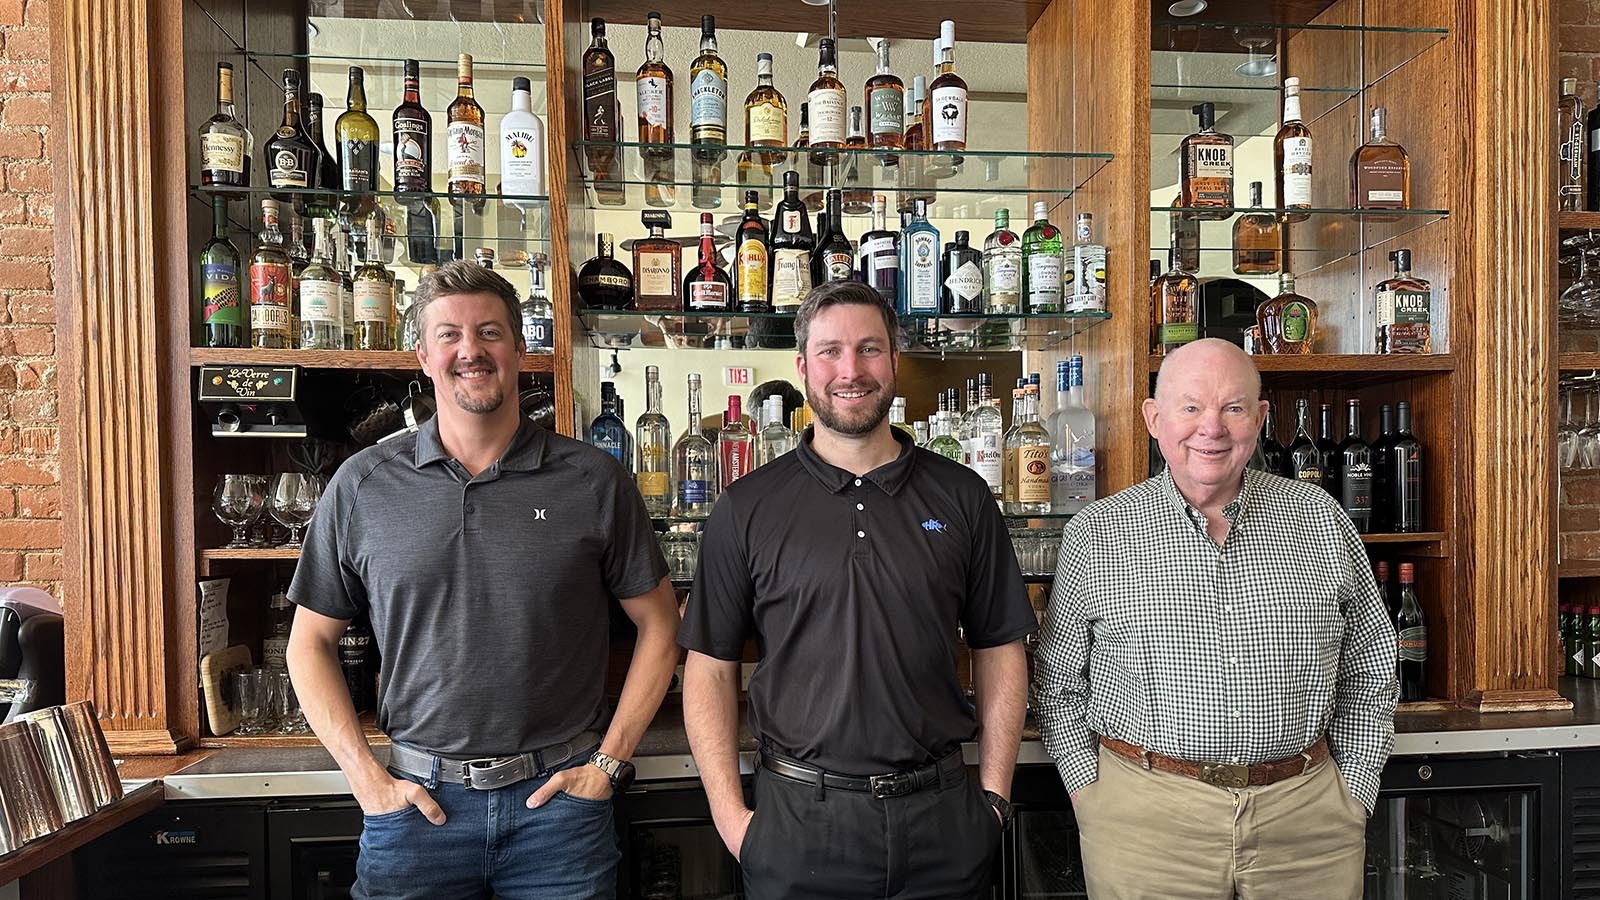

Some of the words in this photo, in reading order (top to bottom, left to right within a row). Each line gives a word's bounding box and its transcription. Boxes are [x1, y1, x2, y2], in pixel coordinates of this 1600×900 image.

[598, 76, 613, 84] LABEL
[395, 120, 423, 131] Goslings
[505, 131, 534, 143] MALIBU
[203, 143, 234, 154] Hennessy
[1198, 148, 1226, 161] KNOB
[915, 236, 932, 245] BOMBAY
[206, 273, 237, 282] VIDA
[585, 275, 628, 285] CHAMBORD
[1396, 294, 1423, 308] KNOB
[227, 368, 242, 378] Le
[241, 368, 270, 378] Verre
[242, 378, 253, 387] de
[235, 387, 256, 396] Vin
[1024, 449, 1049, 459] Tito's
[1356, 495, 1368, 505] 337
[156, 831, 196, 844] KROWNE
